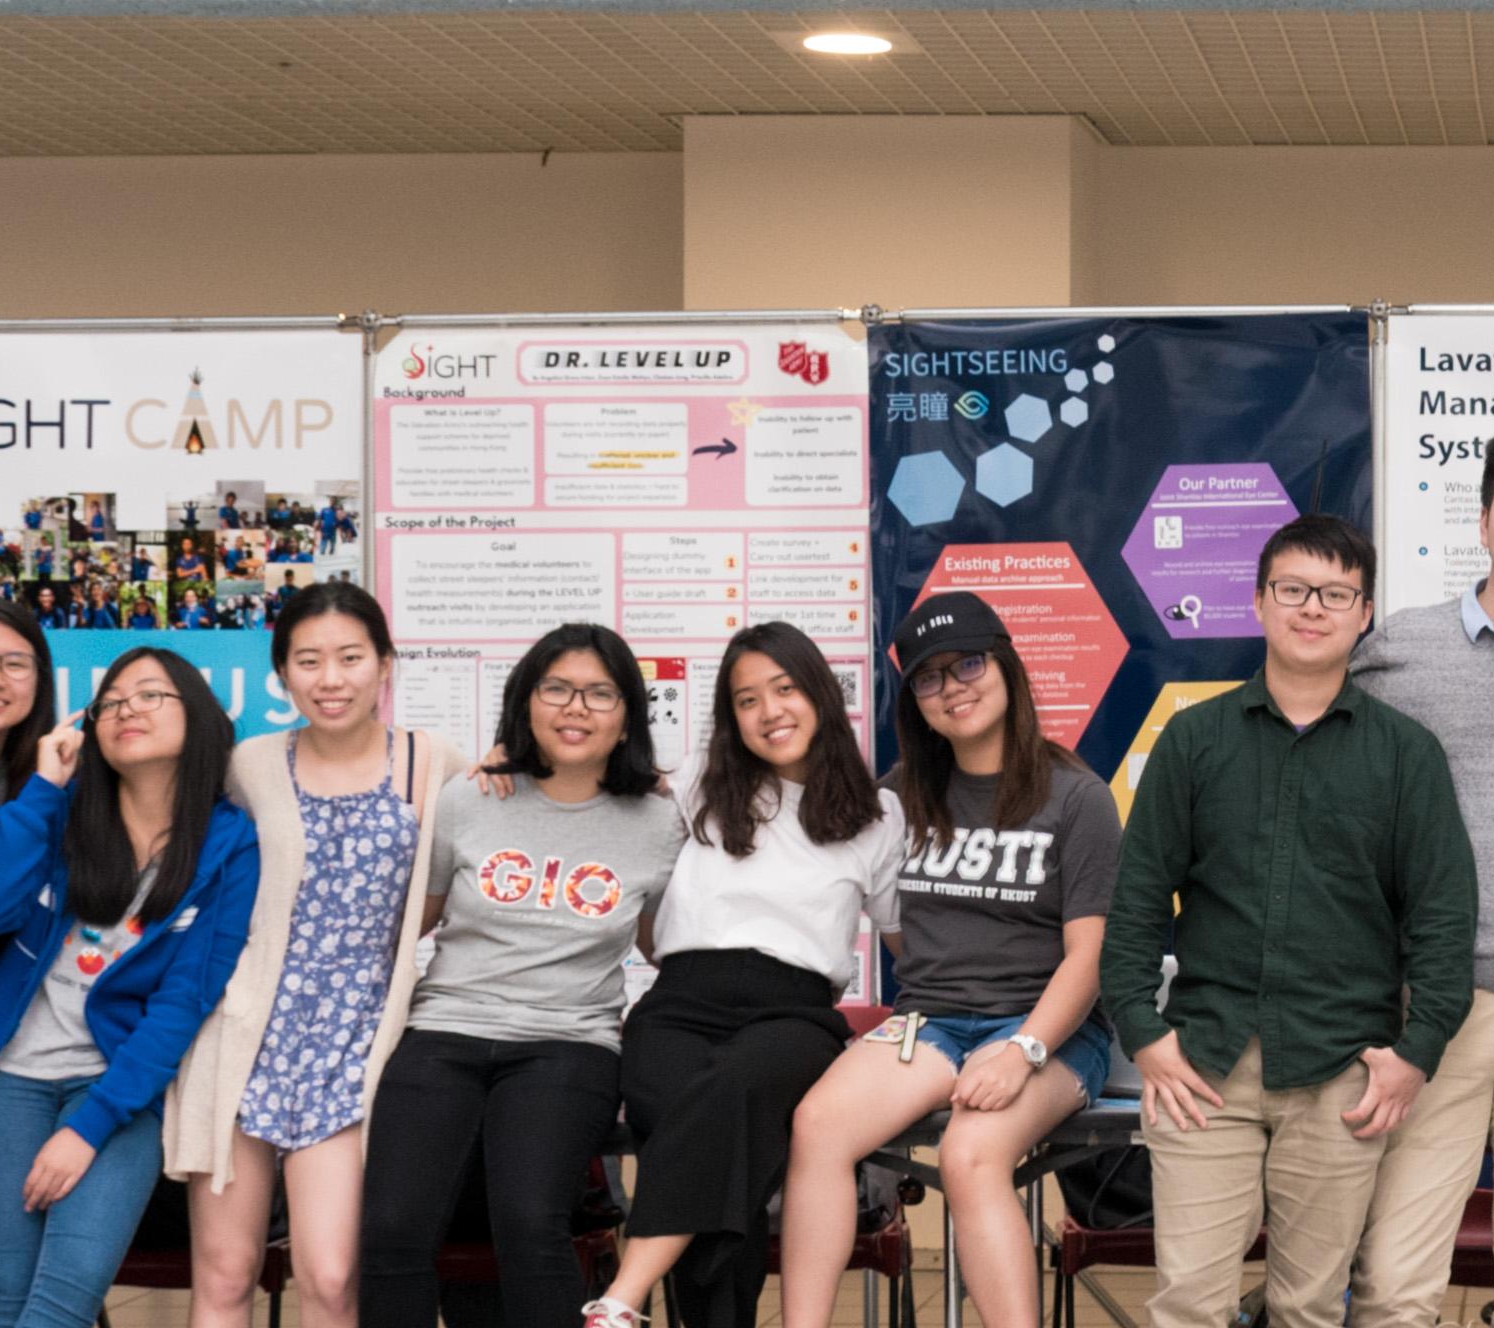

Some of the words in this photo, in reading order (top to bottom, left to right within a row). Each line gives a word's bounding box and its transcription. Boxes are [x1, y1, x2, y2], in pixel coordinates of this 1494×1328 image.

[402, 342, 497, 379] SIGHT
[544, 351, 589, 368] DR.
[600, 351, 684, 368] LEVEL
[696, 351, 731, 368] UP
[885, 349, 1068, 376] SIGHTSEEING
[383, 386, 466, 400] Background
[124, 368, 333, 453] CAMP
[601, 408, 637, 416] Problem
[886, 391, 949, 422] 亮瞳
[1419, 434, 1485, 466] Syst
[1179, 477, 1205, 490] Our
[1209, 476, 1258, 490] Partner
[1444, 482, 1473, 492] Who
[385, 516, 424, 530] Scope
[429, 516, 442, 530] of
[446, 516, 466, 530] the
[470, 516, 516, 530] Project
[491, 542, 517, 551] Goal
[669, 536, 697, 545] Steps
[1444, 546, 1490, 557] Lavato
[495, 561, 529, 570] medical
[532, 561, 580, 570] volunteers
[728, 558, 735, 568] 1
[945, 556, 1001, 572] Existing
[1005, 555, 1070, 570] Practices
[555, 588, 585, 598] LEVEL
[588, 588, 602, 598] UP
[1013, 633, 1075, 642] examination
[394, 649, 423, 659] sign
[427, 647, 481, 658] Evolution
[1031, 671, 1065, 682] chiving
[478, 847, 623, 918] GIO
[933, 882, 984, 899] STUDENTS
[985, 886, 998, 900] OF
[1000, 887, 1037, 903] HKUST
